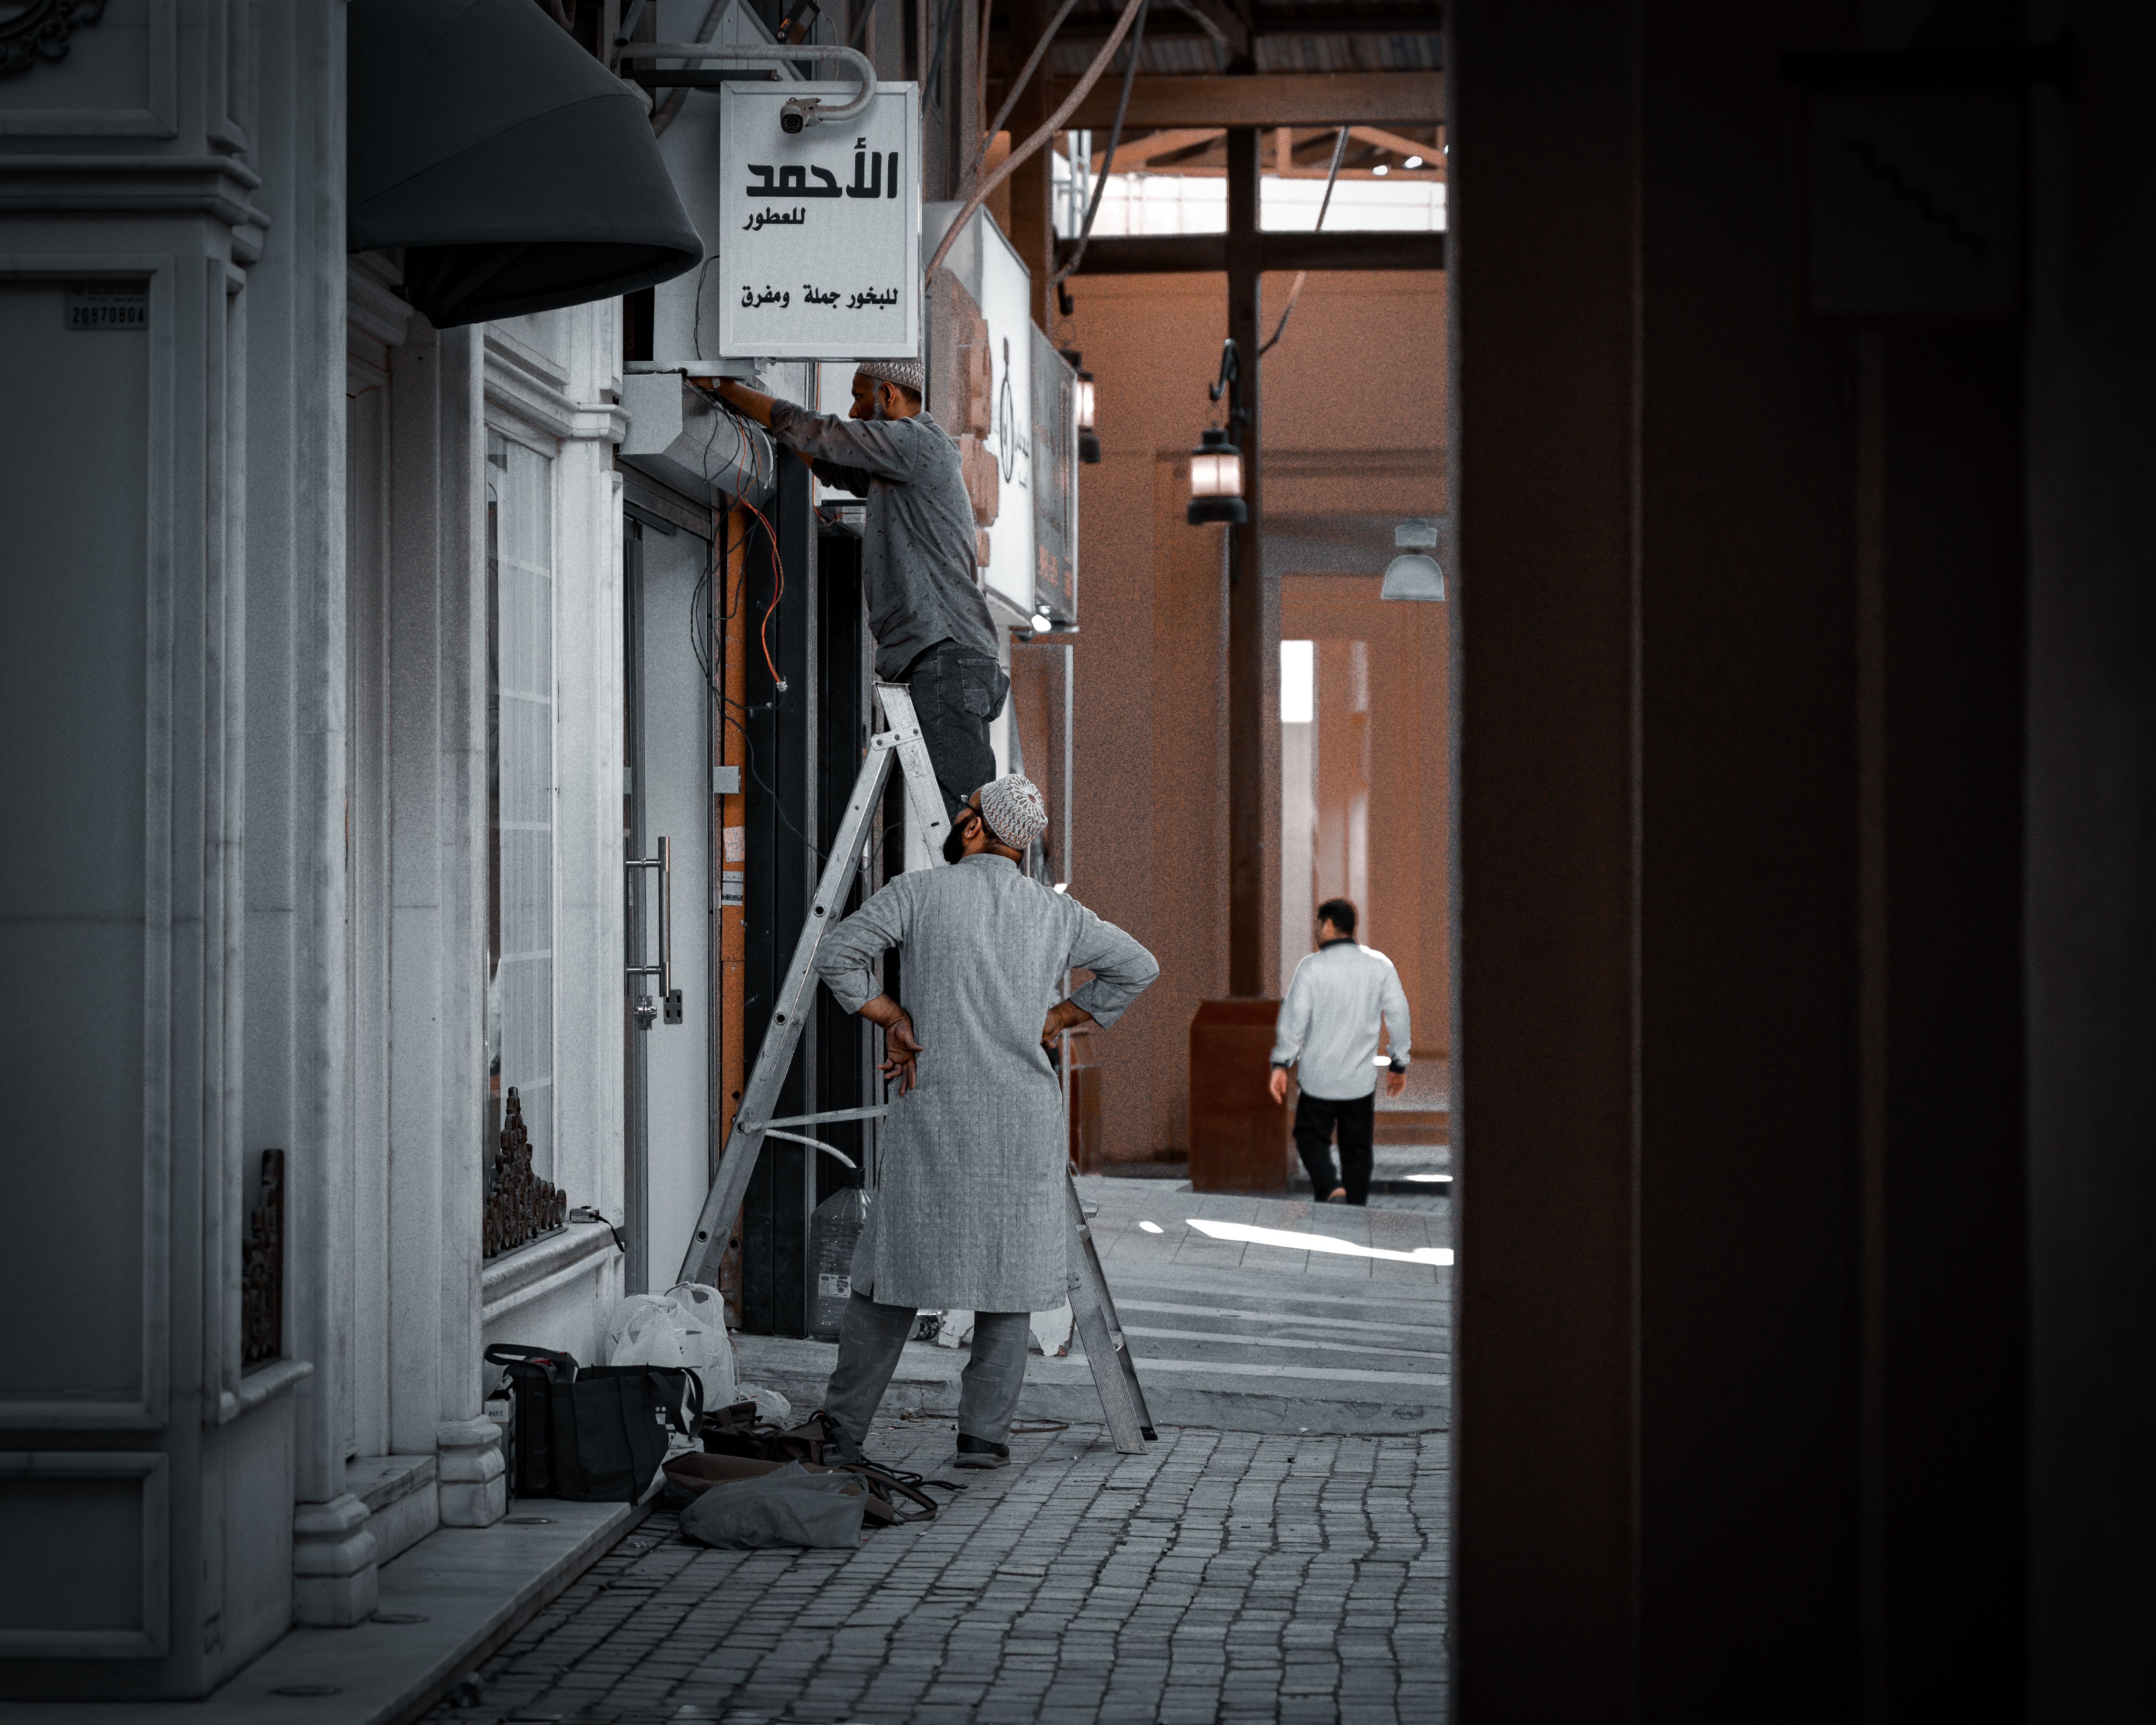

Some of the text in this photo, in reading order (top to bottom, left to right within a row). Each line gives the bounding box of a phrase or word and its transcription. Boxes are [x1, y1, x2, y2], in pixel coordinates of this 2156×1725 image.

[746, 137, 898, 199] الأحمد
[742, 207, 806, 231] للعطور
[741, 284, 898, 310] للبخور جملة ومفرق
[73, 307, 144, 323] 20870804
